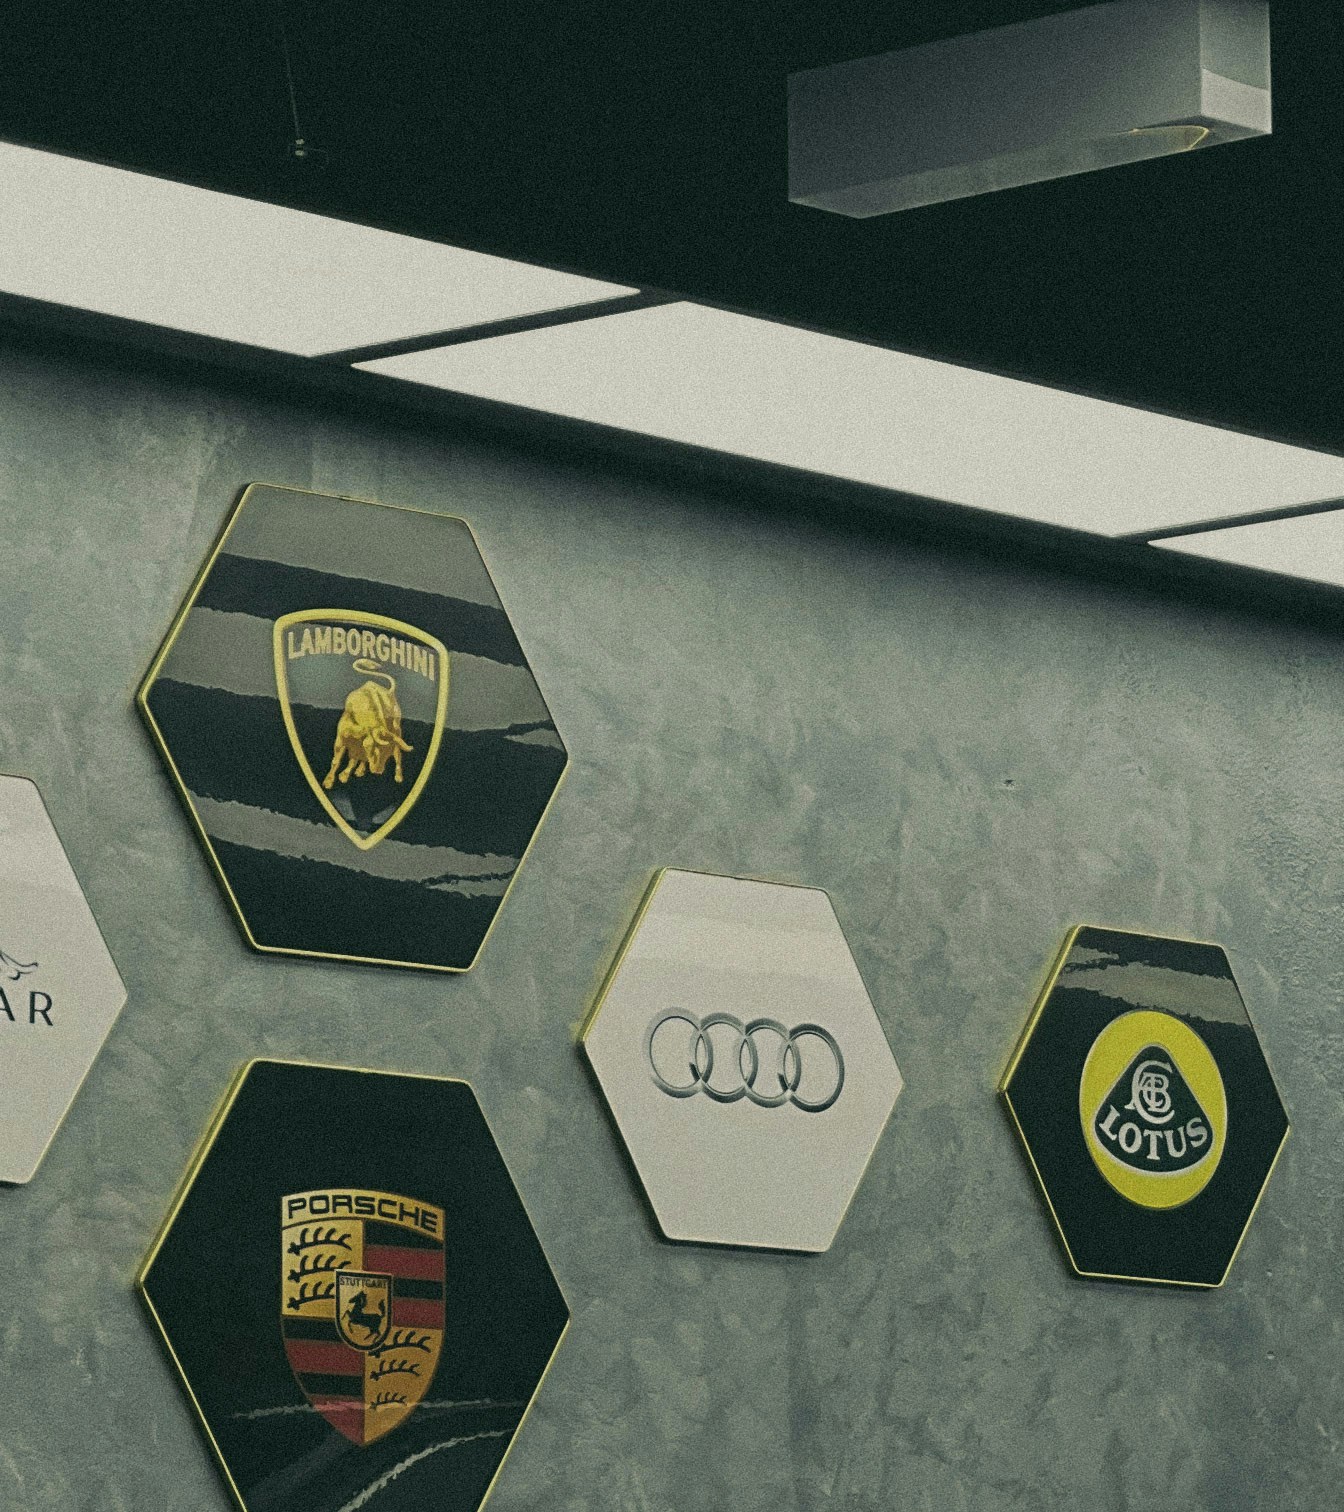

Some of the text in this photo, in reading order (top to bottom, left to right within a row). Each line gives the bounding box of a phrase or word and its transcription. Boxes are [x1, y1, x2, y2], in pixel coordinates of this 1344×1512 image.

[287, 626, 436, 682] LAMBORGHINI
[1098, 1104, 1209, 1161] LOTUS
[286, 1194, 438, 1234] PORSCHE
[339, 1275, 388, 1290] STUTTGART
